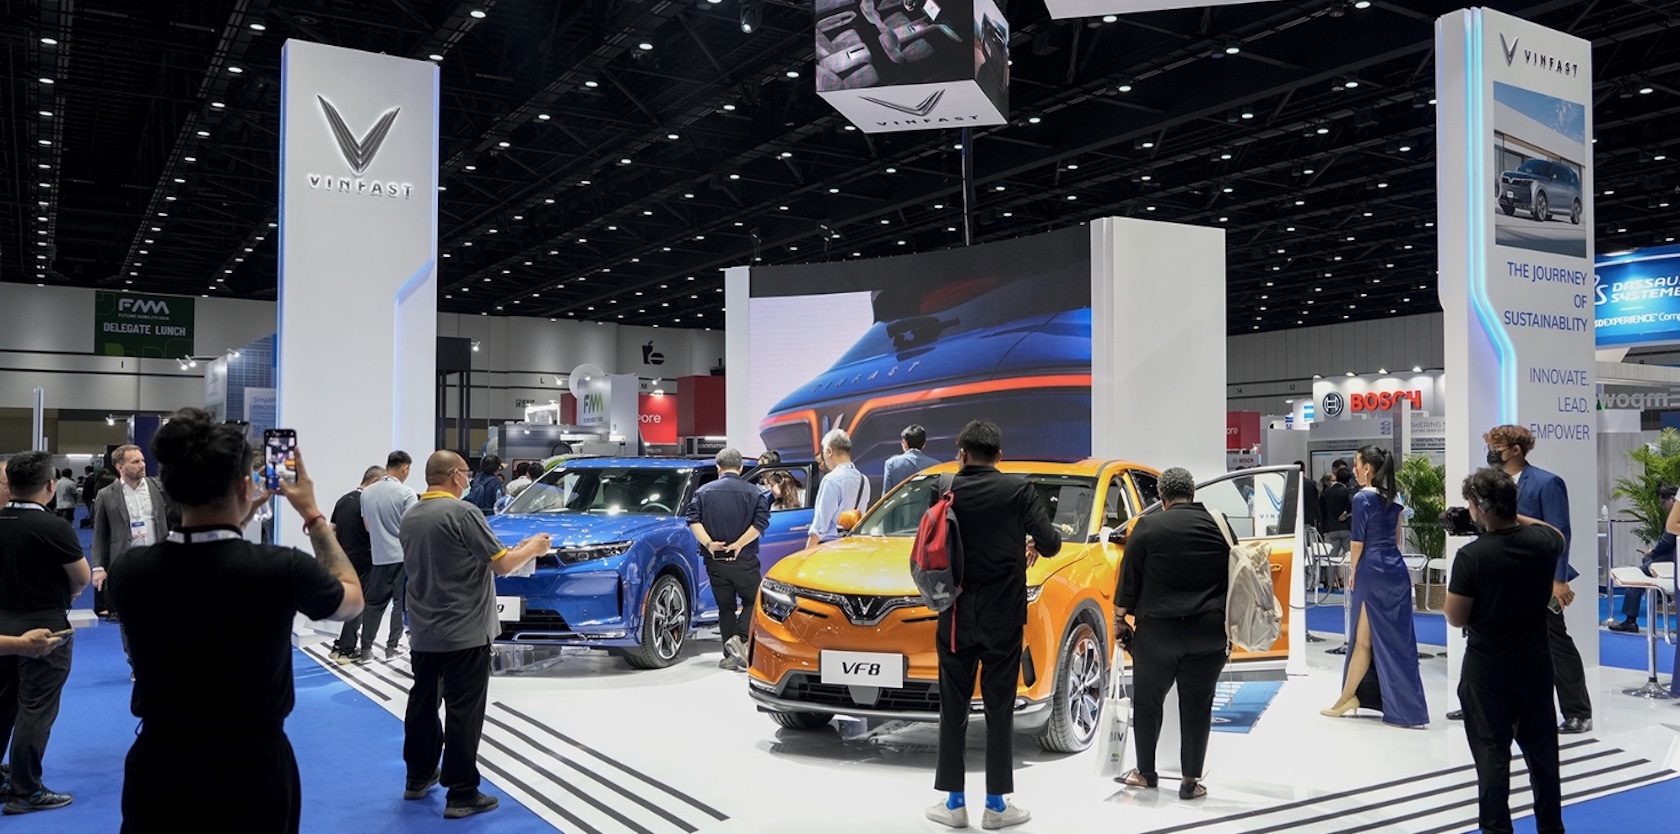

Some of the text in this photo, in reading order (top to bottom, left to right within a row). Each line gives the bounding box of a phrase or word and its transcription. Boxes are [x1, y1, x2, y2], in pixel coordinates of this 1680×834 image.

[1524, 50, 1578, 77] VINFAST
[876, 115, 979, 126] VINFAST
[308, 174, 414, 199] VINFAST
[1507, 261, 1588, 286] THE JOURRNEY
[1612, 276, 1680, 292] DASSAU
[1574, 294, 1587, 309] OF
[1504, 310, 1588, 332] SUSTAINABLITY
[103, 323, 186, 337] DELEGATE LUNCH
[1529, 367, 1590, 386] INNOVATE.
[1558, 397, 1590, 413] LEAD.
[638, 414, 661, 424] ore
[1530, 423, 1590, 440] EMPOWER
[842, 661, 881, 676] VF8
